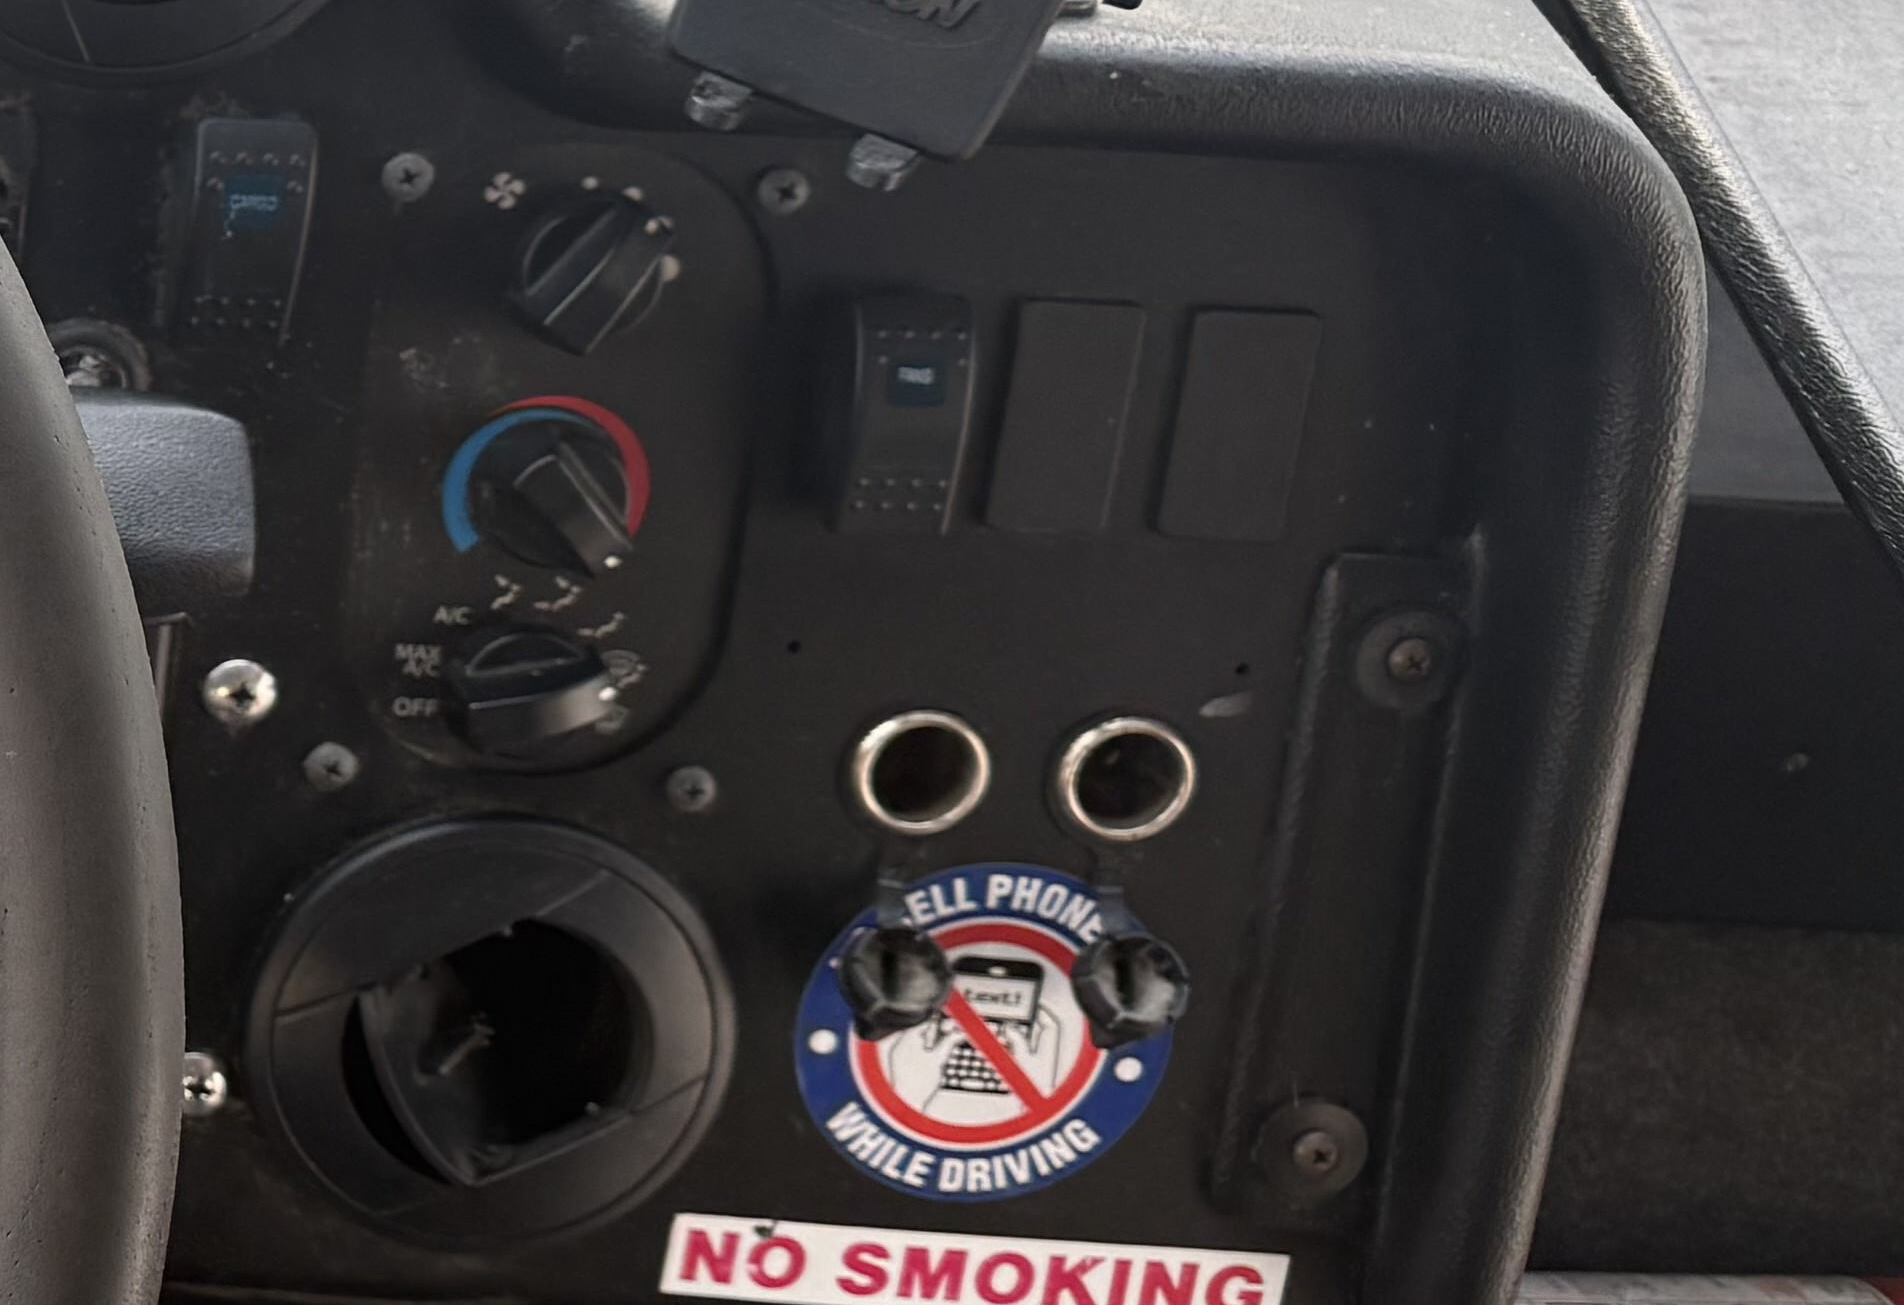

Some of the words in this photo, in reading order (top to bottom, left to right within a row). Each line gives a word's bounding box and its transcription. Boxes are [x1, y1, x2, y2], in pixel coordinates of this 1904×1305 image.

[392, 696, 440, 717] OFF
[900, 877, 978, 927] ELL
[825, 1100, 936, 1188] WHILE
[938, 1117, 1103, 1193] DRIVING
[679, 1227, 808, 1290] NO
